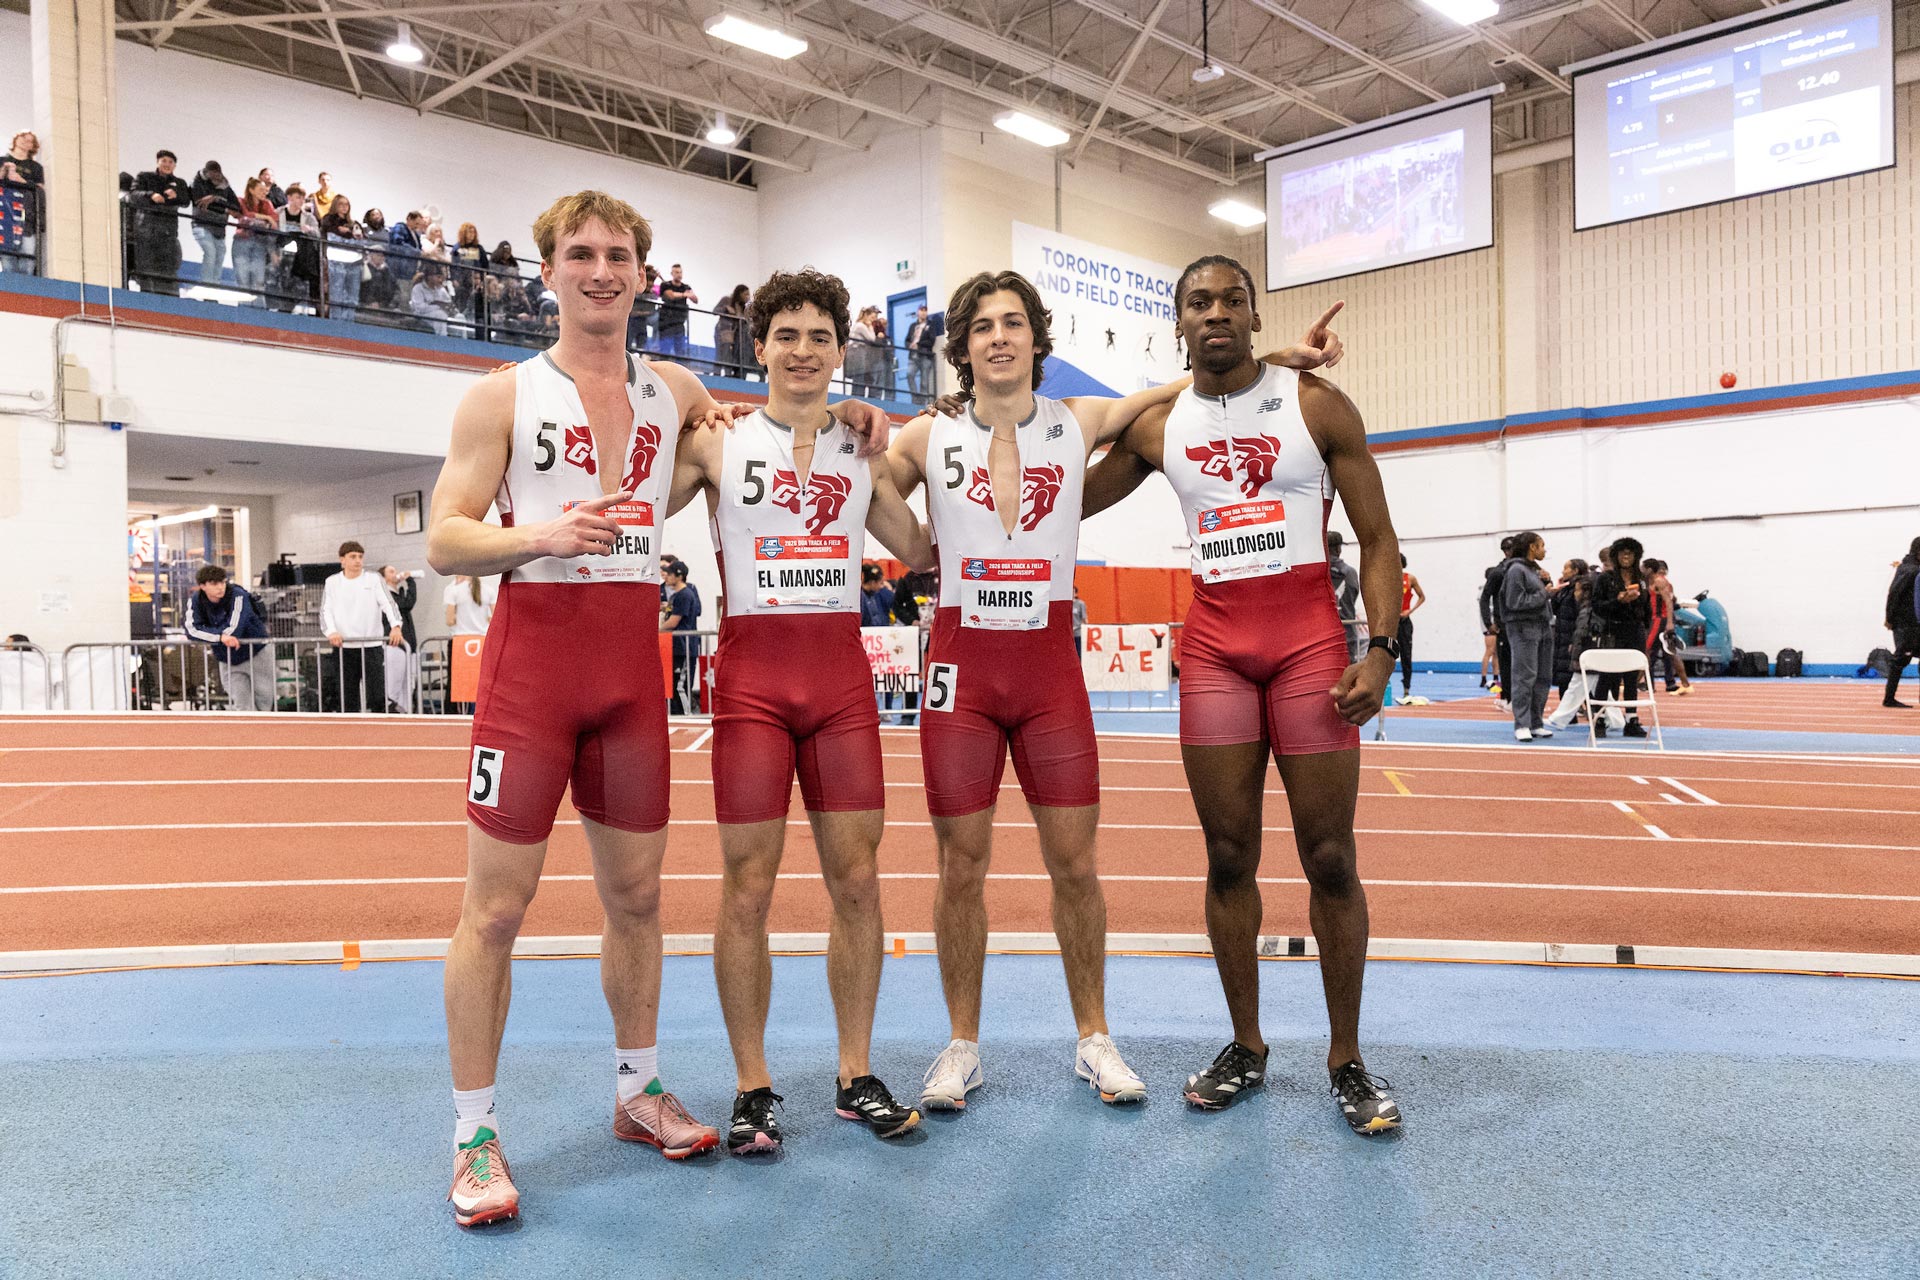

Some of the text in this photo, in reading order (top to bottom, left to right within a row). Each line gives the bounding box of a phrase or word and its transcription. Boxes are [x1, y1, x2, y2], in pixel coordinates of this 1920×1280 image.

[1797, 70, 1840, 91] 12.40
[1769, 131, 1840, 156] OUA
[1041, 246, 1175, 299] TORONTO TRACK
[1034, 270, 1177, 322] AND FIELD CENTRE
[534, 422, 557, 471] 5
[943, 445, 965, 490] 5
[742, 460, 766, 505] 5
[1229, 512, 1267, 522] CHAMPIONSHIPS
[1241, 506, 1256, 514] TRACK
[608, 536, 650, 555] PEAU
[1201, 531, 1286, 560] MOULONGOU
[758, 568, 846, 588] EL MANSARI
[978, 589, 1033, 608] HARRIS
[874, 673, 919, 692] HUNT
[930, 665, 950, 709] 5
[473, 749, 496, 802] 5
